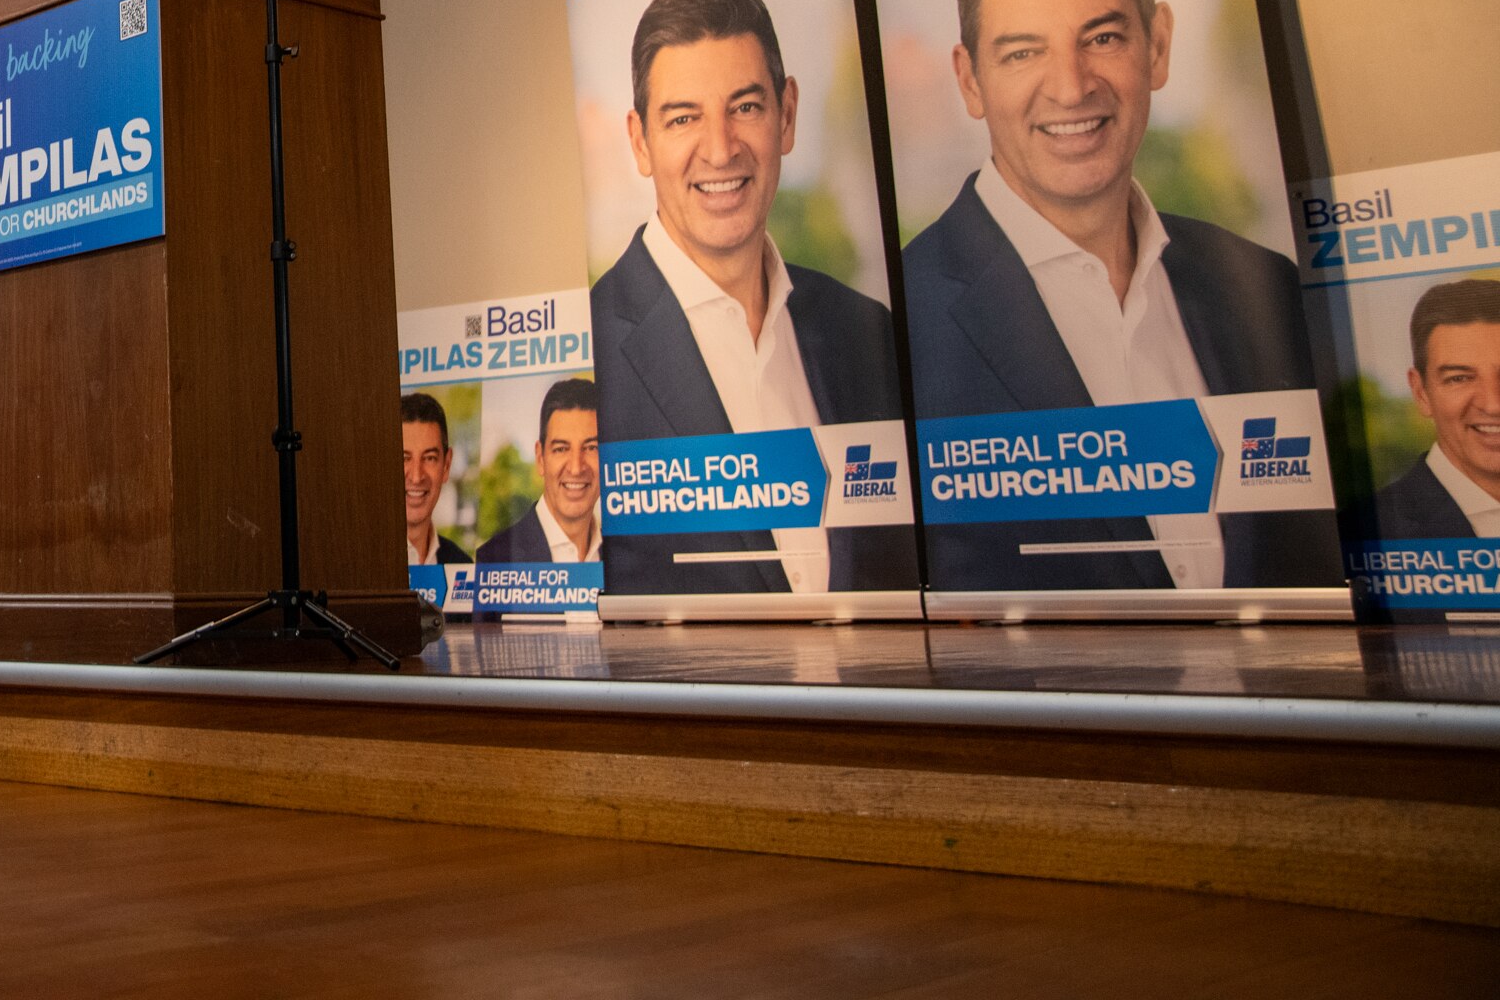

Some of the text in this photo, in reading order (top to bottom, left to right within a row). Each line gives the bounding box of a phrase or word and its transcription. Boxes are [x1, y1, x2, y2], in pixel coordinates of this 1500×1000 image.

[6, 25, 96, 82] backing
[22, 182, 148, 231] CHURCHLANDS
[1302, 188, 1393, 230] Basil
[1307, 209, 1500, 269] ZEMPI
[487, 299, 555, 337] Basil
[400, 341, 483, 376] PILAS
[487, 331, 590, 370] ZEMPI
[928, 429, 1128, 469] LIBERAL FOR
[604, 453, 759, 487] LIBERAL FOR
[931, 460, 1196, 501] CHURCHLANDS
[1240, 459, 1311, 479] LIBERAL
[606, 481, 810, 516] CHURCHLANDS
[843, 481, 897, 498] LIBERAL
[479, 569, 569, 586] LIBERAL FOR
[1349, 550, 1455, 572] LIBERAL
[478, 587, 599, 604] CHURCHLANDS
[1357, 574, 1500, 595] HURCHL
